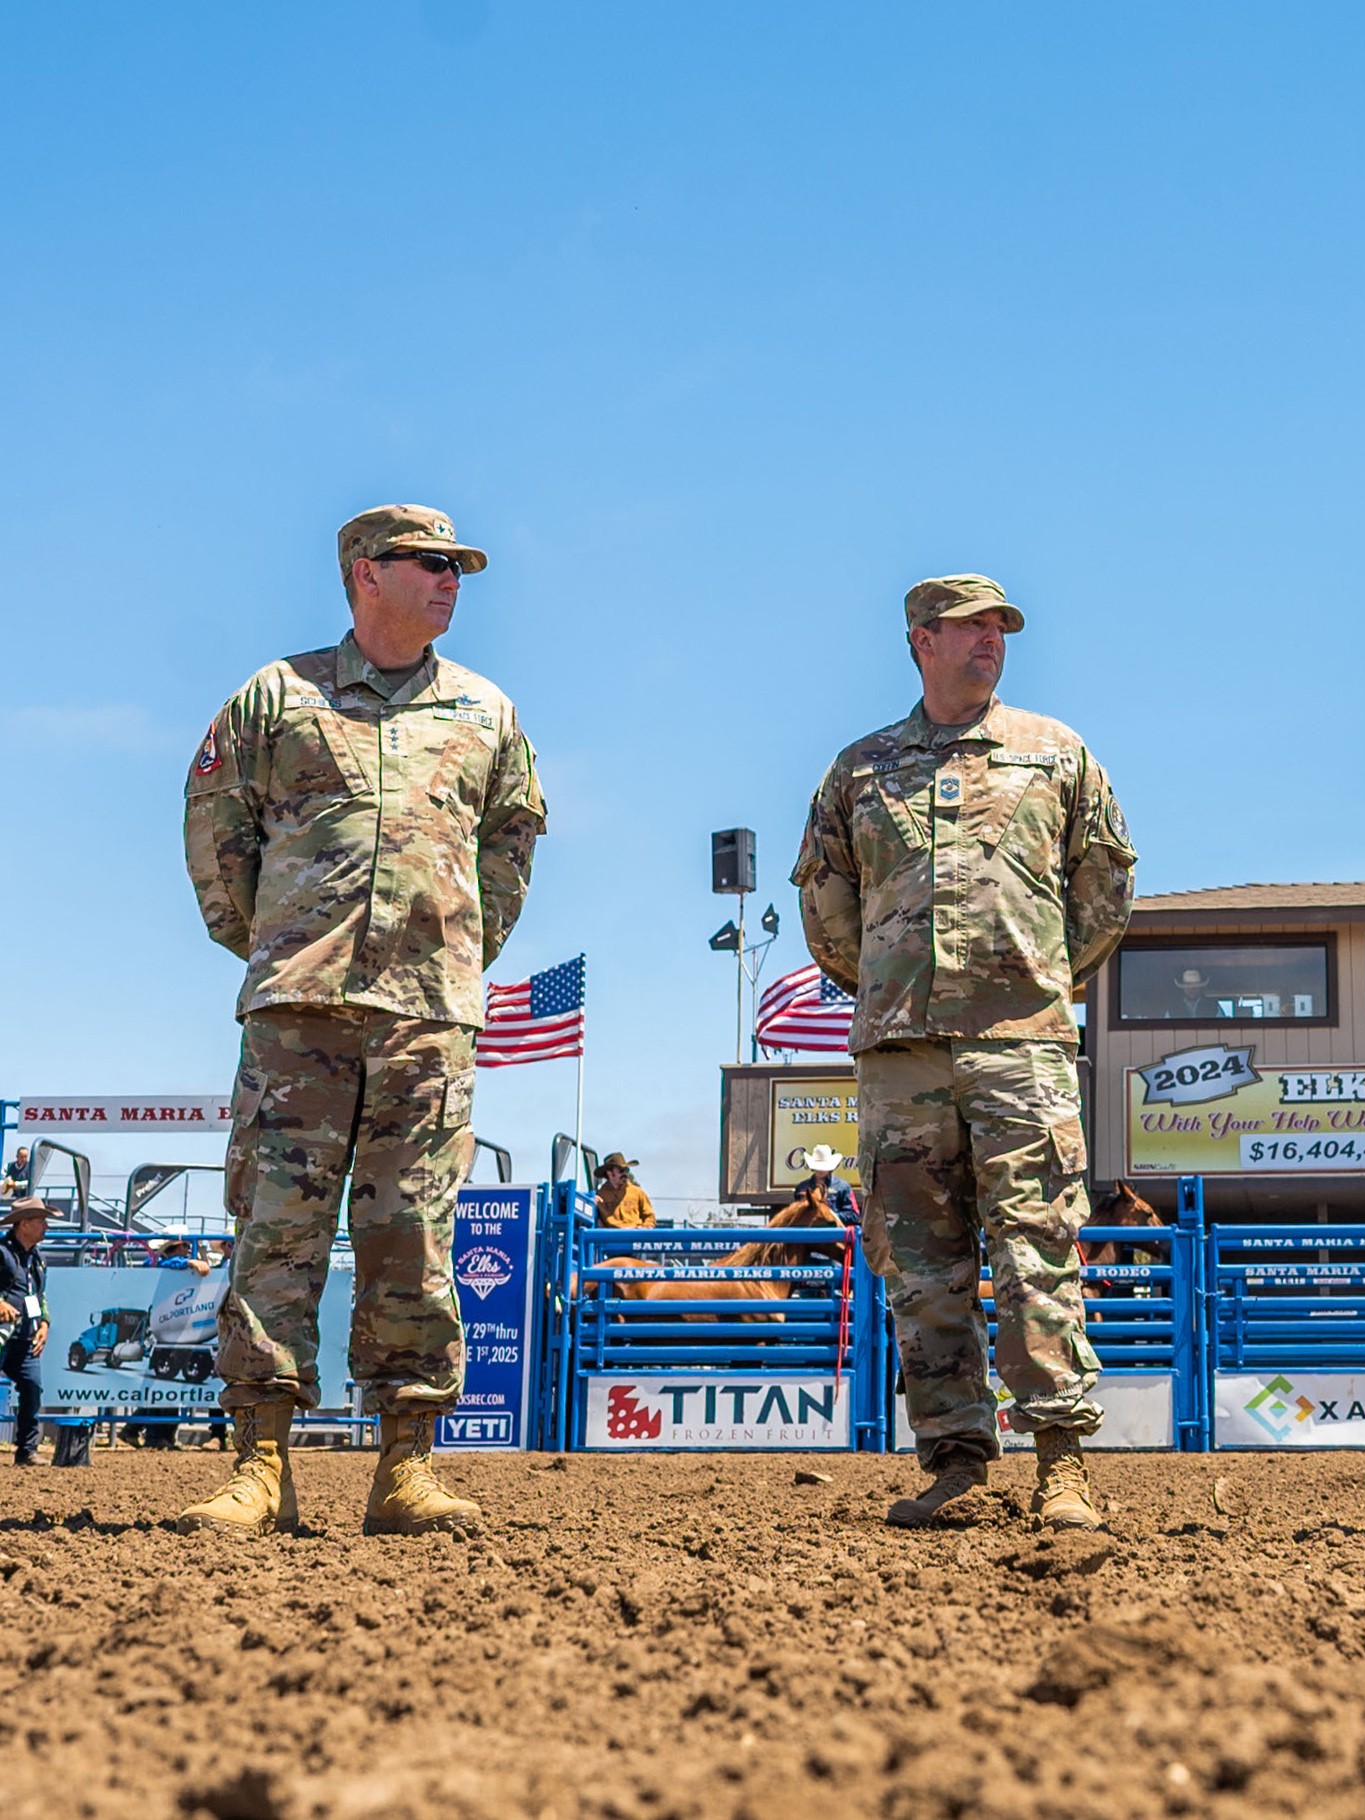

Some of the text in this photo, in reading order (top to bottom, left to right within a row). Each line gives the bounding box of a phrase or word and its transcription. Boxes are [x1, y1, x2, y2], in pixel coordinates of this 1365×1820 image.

[1154, 1055, 1245, 1091] 2024
[778, 1096, 841, 1109] SANTA
[24, 1107, 108, 1121] SANTA
[120, 1107, 206, 1121] MARIA
[792, 1111, 841, 1124] ELKS
[1140, 1112, 1202, 1132] With
[1208, 1111, 1265, 1139] Your
[1271, 1110, 1320, 1132] Help
[455, 1202, 519, 1219] WELCOME
[470, 1223, 502, 1235] TO THE
[633, 1242, 741, 1250] SANTA MARIA
[1243, 1238, 1294, 1246] SANTA
[467, 1254, 501, 1274] Elks
[613, 1269, 835, 1279] SANTA MARIA ELKS RODEO
[1096, 1267, 1151, 1277] RODEO
[1245, 1267, 1299, 1277] SANTA
[1306, 1267, 1361, 1276] MARIA
[496, 1323, 518, 1340] thru
[58, 1387, 215, 1405] www.calportla
[658, 1385, 834, 1424] TITAN
[1319, 1401, 1344, 1420] X
[448, 1418, 508, 1439] YETI
[673, 1429, 835, 1440] FROZEN FRUIT
